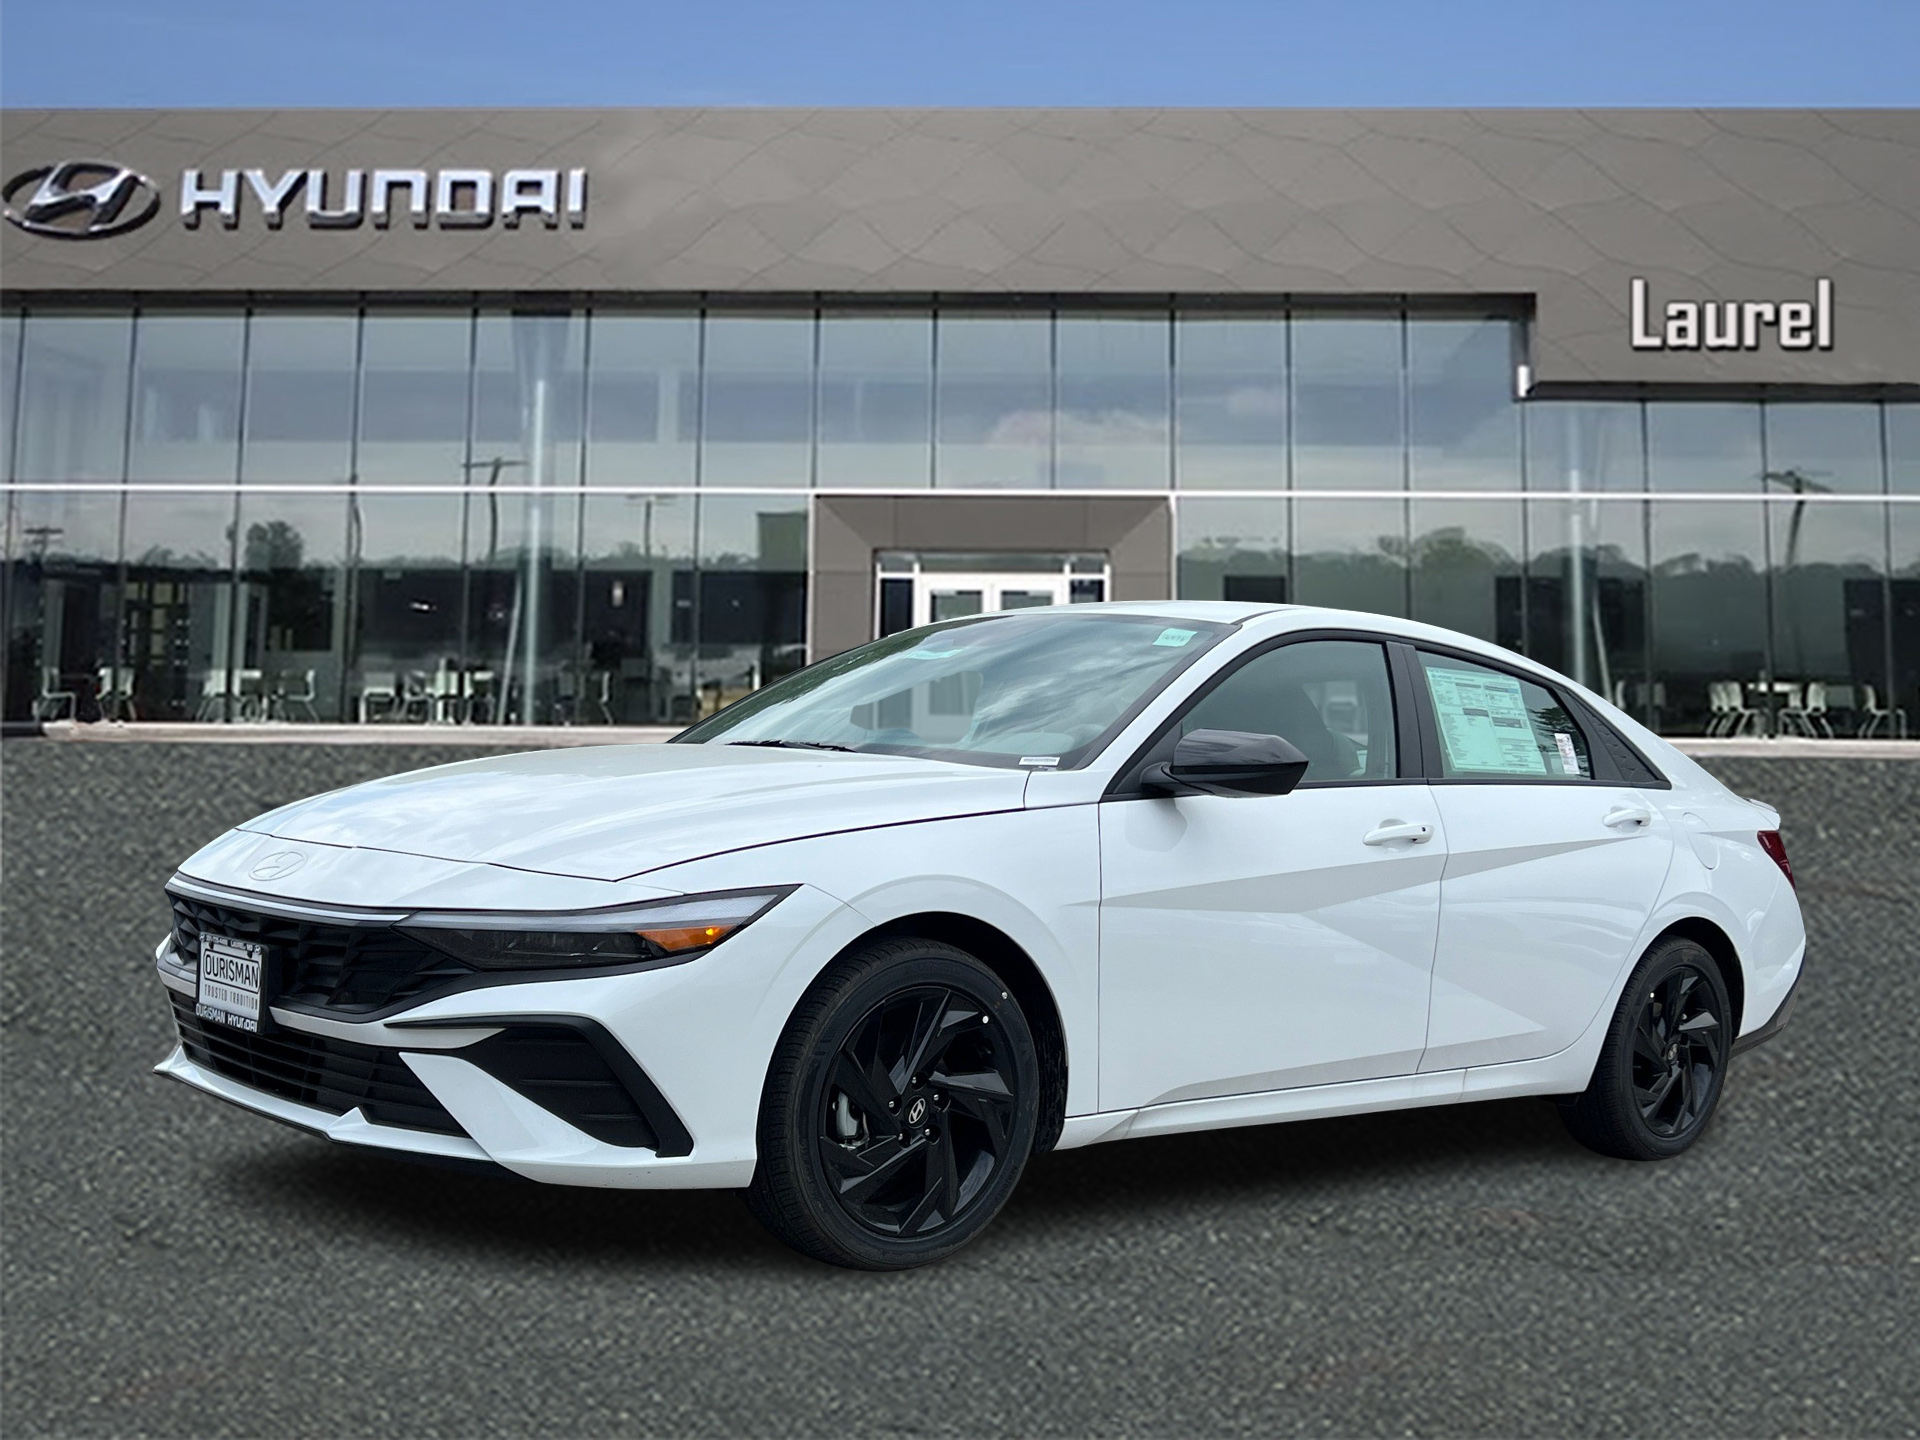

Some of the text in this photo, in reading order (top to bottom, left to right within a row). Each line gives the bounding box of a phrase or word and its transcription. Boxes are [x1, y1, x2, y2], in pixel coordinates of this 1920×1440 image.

[181, 168, 587, 228] HYUNDAI
[1632, 279, 1830, 347] Laurel
[205, 954, 258, 988] OURISMAN
[204, 984, 258, 1010] TRUSTED TRADITION
[195, 1003, 258, 1033] OURISMAN HYUNDAI
